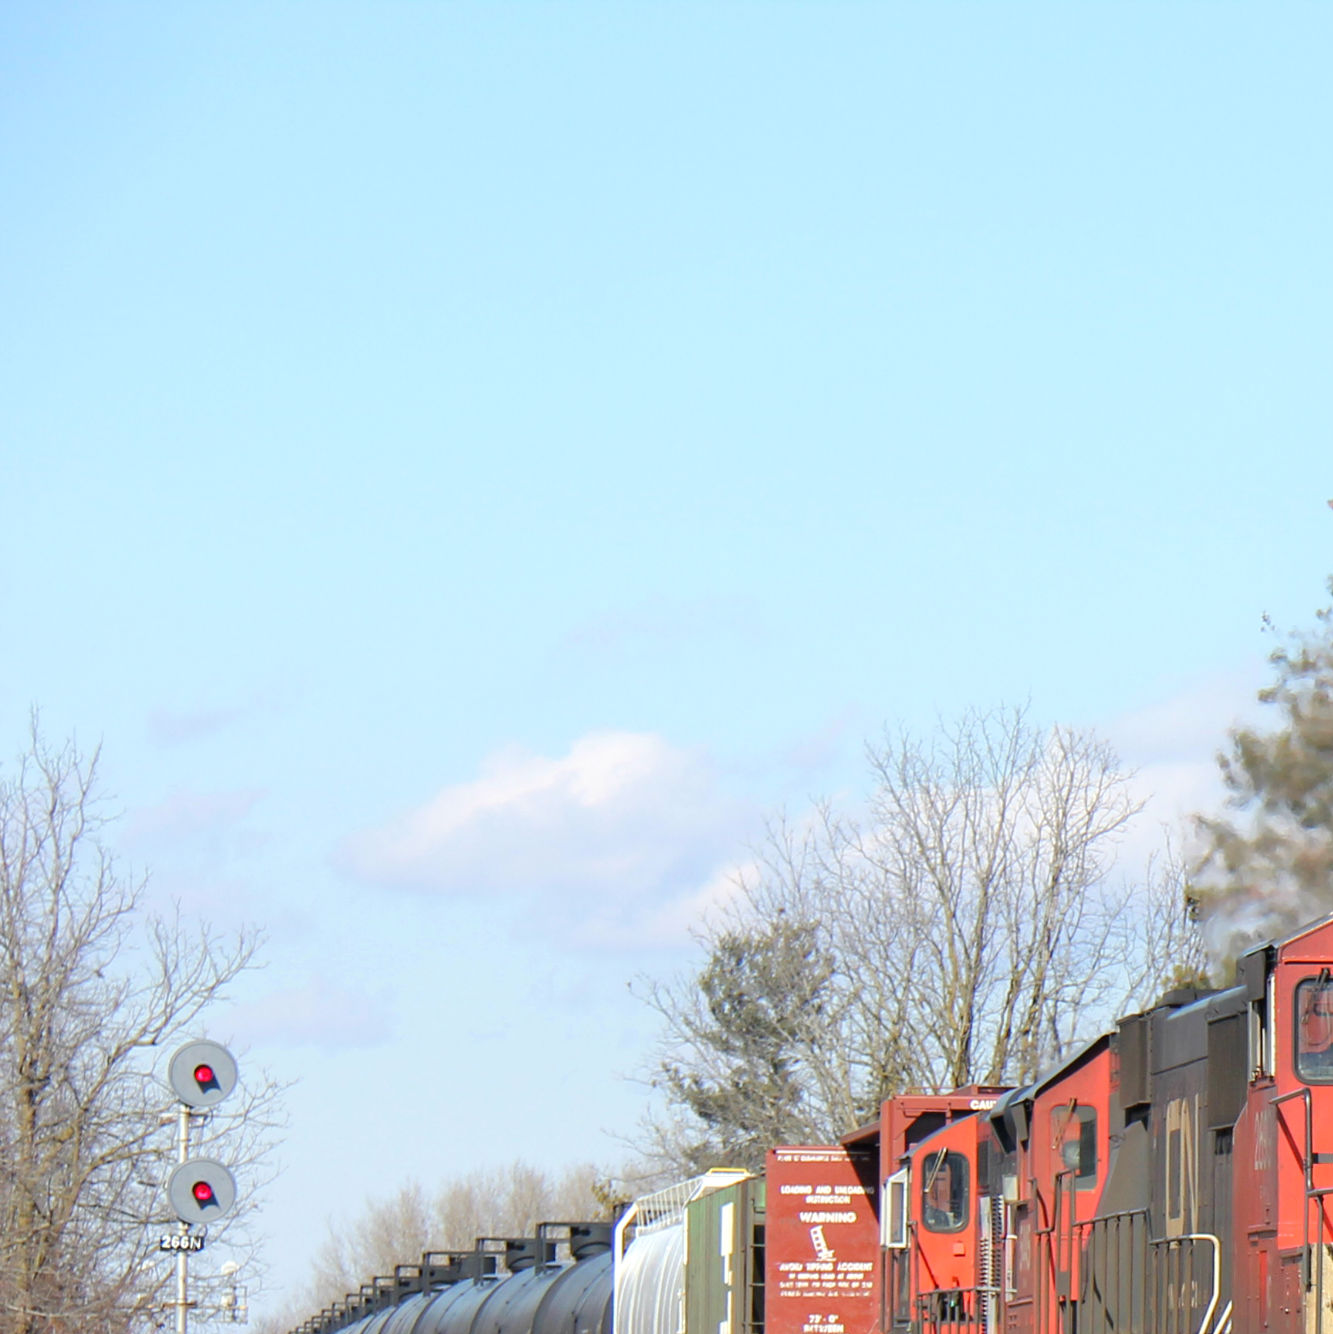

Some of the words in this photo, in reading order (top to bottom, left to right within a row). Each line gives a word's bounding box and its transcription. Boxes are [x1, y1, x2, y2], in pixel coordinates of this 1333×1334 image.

[816, 1185, 832, 1194] AND
[800, 1212, 857, 1223] WARNING
[161, 1235, 202, 1249] 266N
